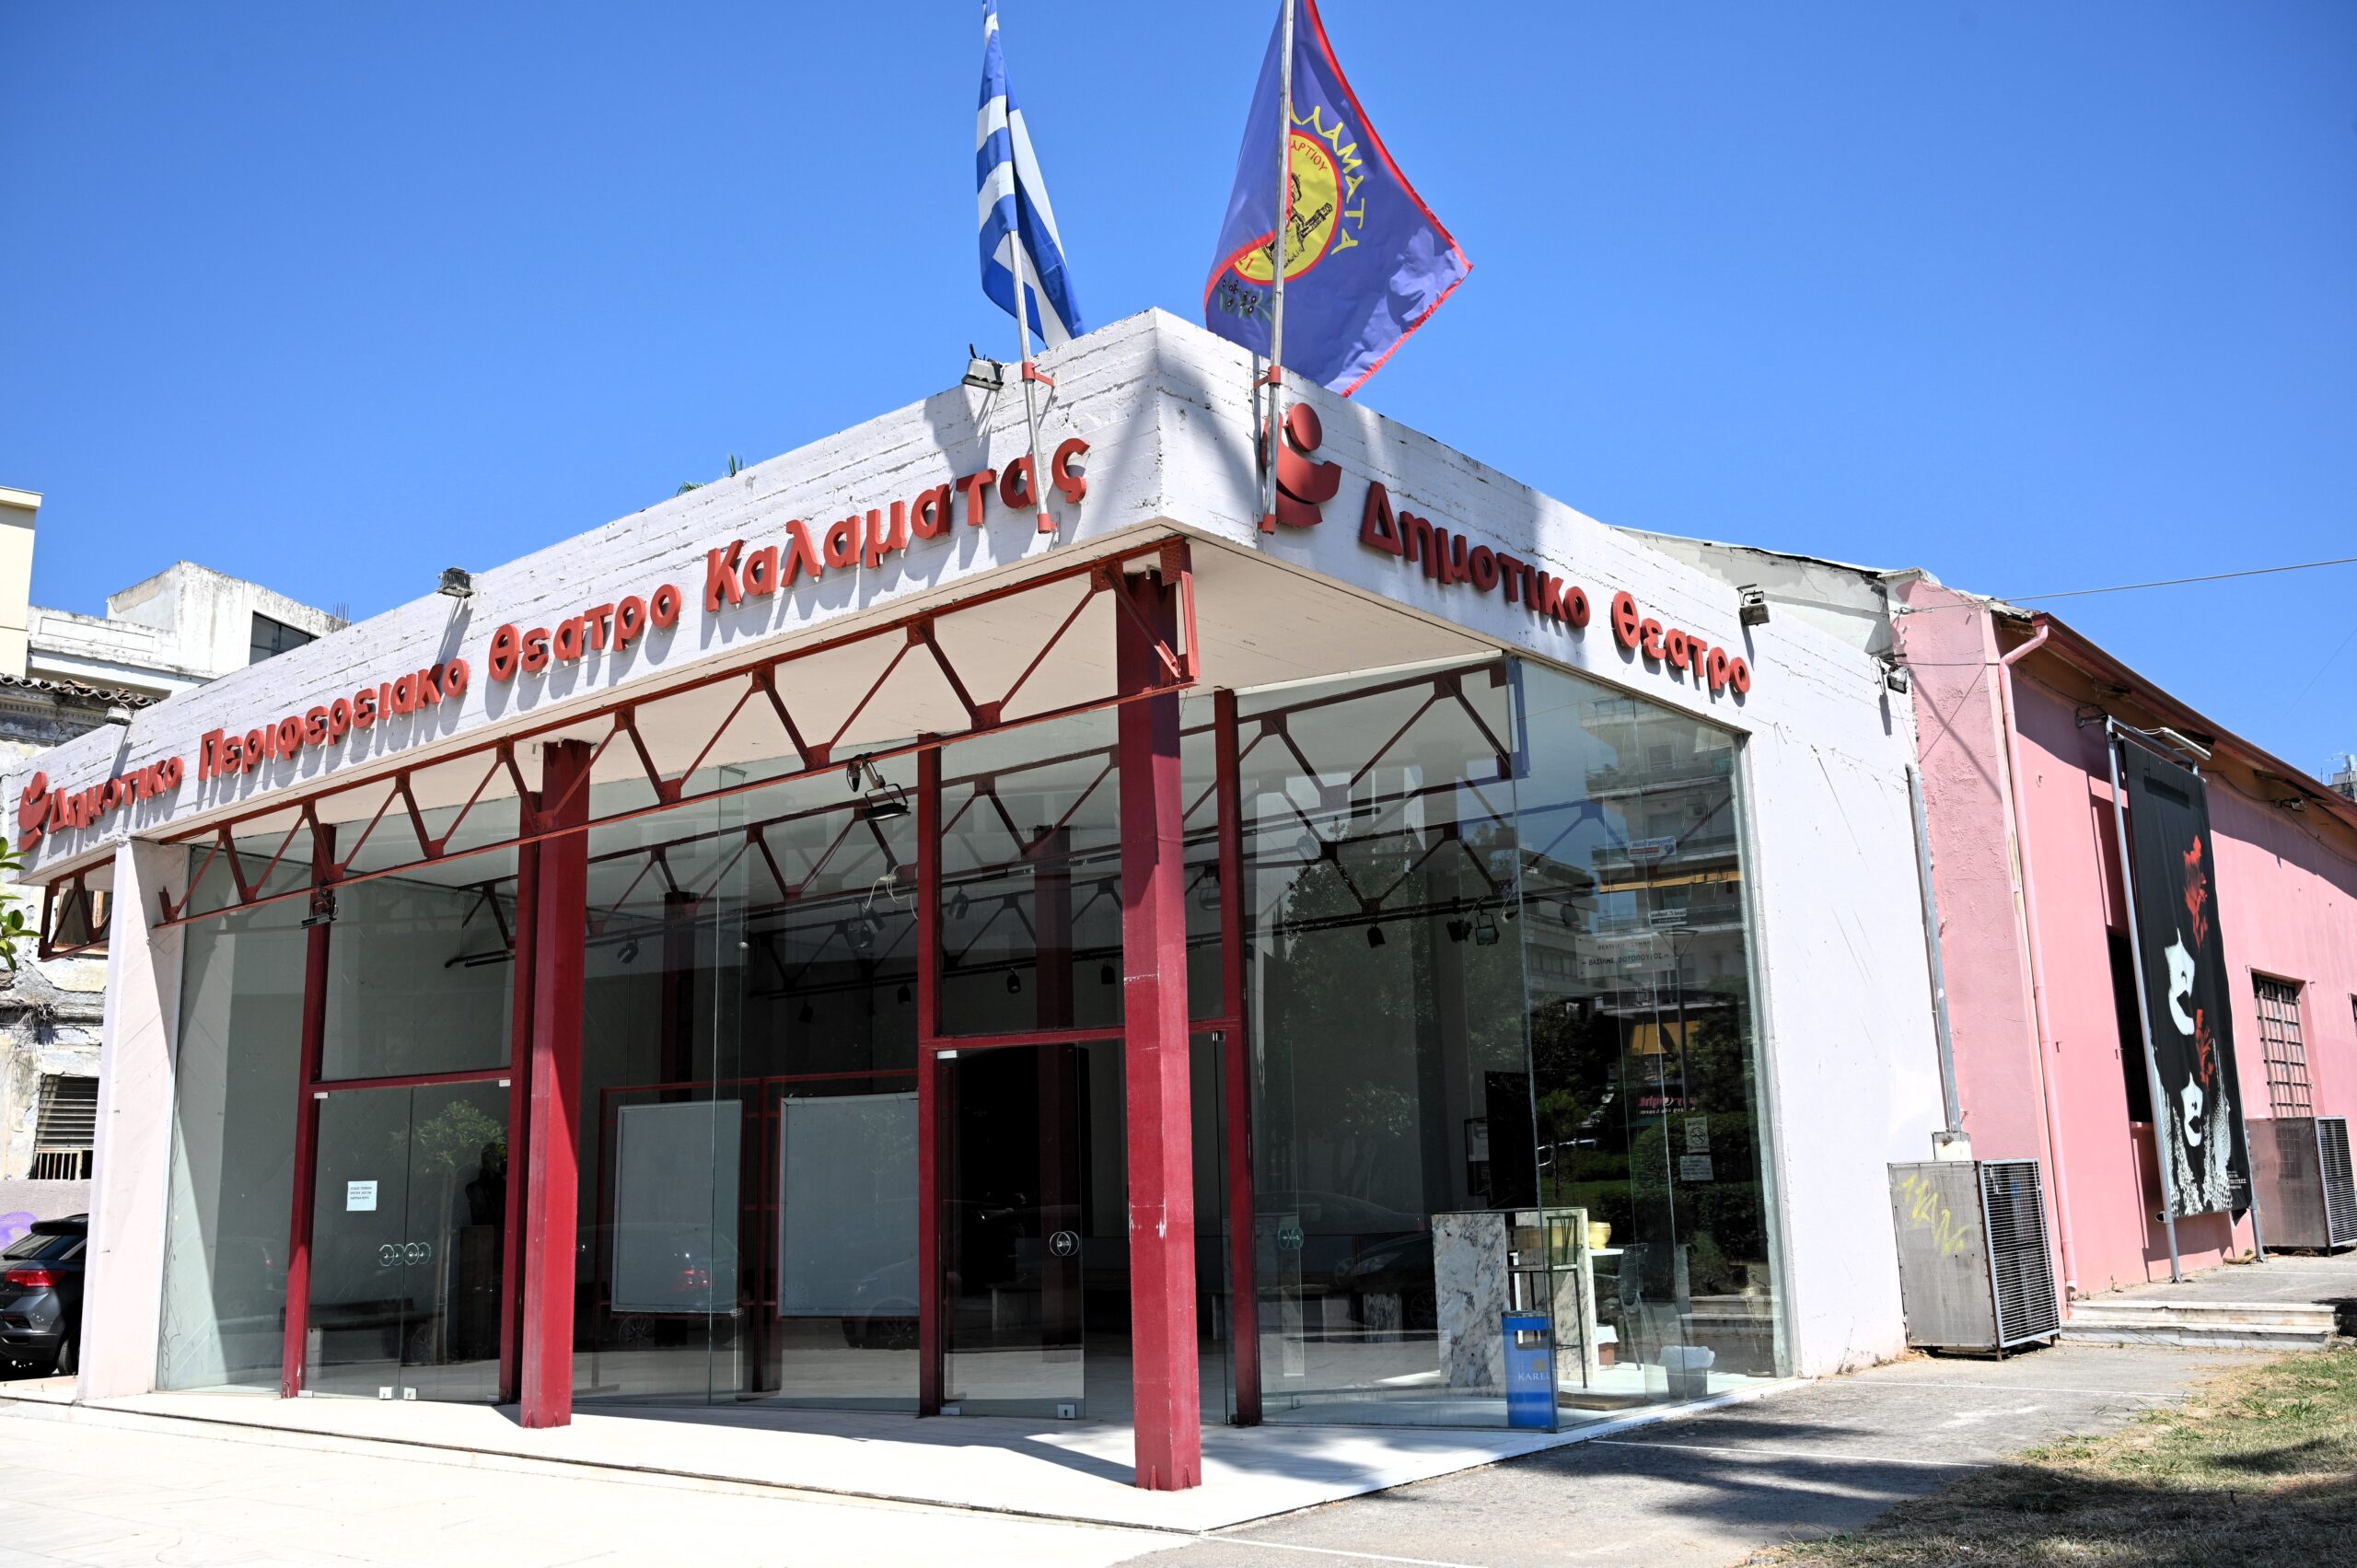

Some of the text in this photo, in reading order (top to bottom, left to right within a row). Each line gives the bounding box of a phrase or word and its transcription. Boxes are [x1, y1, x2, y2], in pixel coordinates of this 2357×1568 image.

[1289, 139, 1329, 171] ΑΡΤΙΟΥ
[1291, 100, 1364, 255] ΛΑΜΑΤΑ
[1360, 481, 1591, 628] Δημοτικο
[48, 437, 1090, 834] Δημοτικο Περιφερειακο Θεατρο Καλαματας
